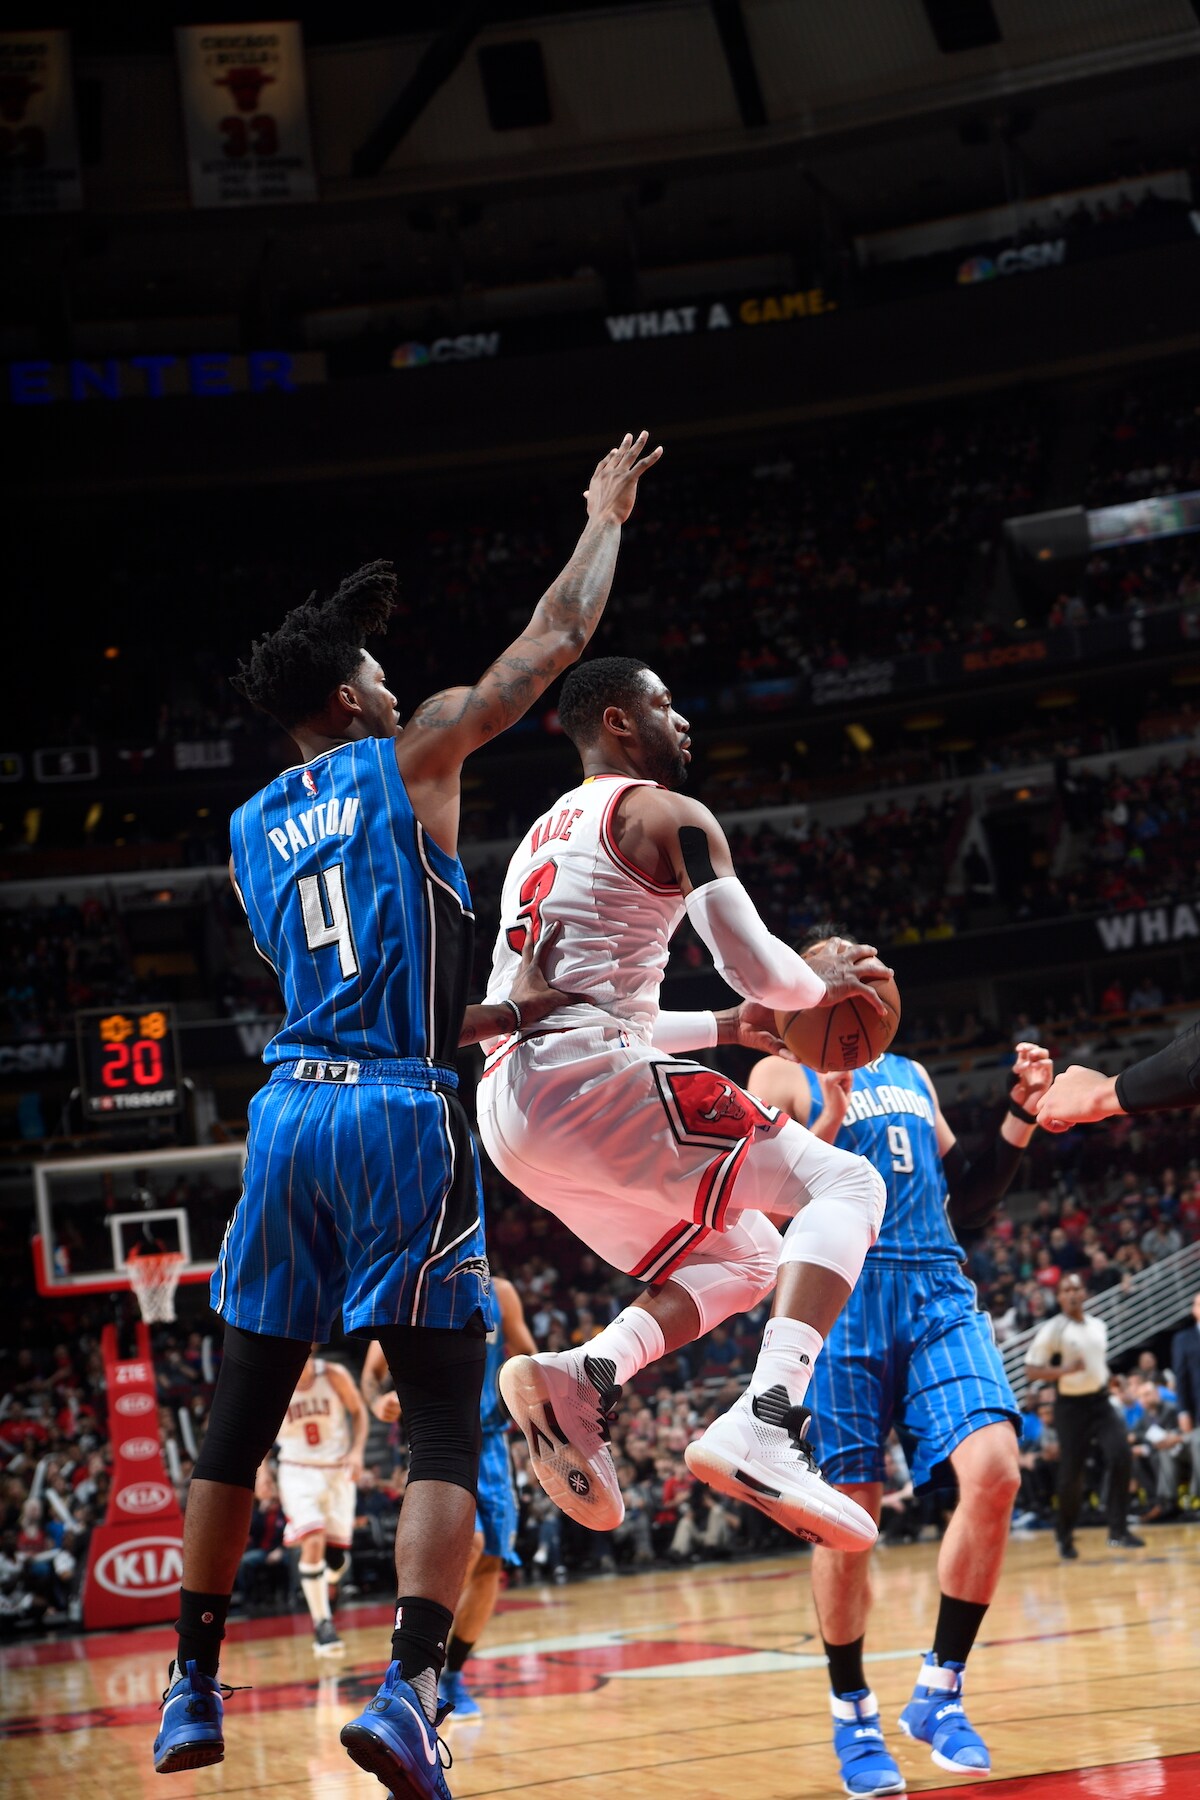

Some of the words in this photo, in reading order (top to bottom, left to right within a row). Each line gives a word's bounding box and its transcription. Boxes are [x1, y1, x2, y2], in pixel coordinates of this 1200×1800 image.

[219, 115, 278, 157] 33
[996, 237, 1067, 275] CSN
[604, 306, 699, 343] WHAT
[706, 301, 732, 331] A
[430, 330, 501, 363] CSN
[8, 350, 298, 407] ENTER
[268, 797, 360, 861] PAYTON
[296, 862, 360, 981] 4
[505, 857, 559, 957] 3
[102, 1039, 164, 1089] 20
[114, 1090, 177, 1110] TISSOT
[887, 1125, 914, 1174] 9
[115, 1363, 147, 1383] ZTE
[304, 1421, 321, 1447] 8
[124, 1487, 162, 1507] KIA
